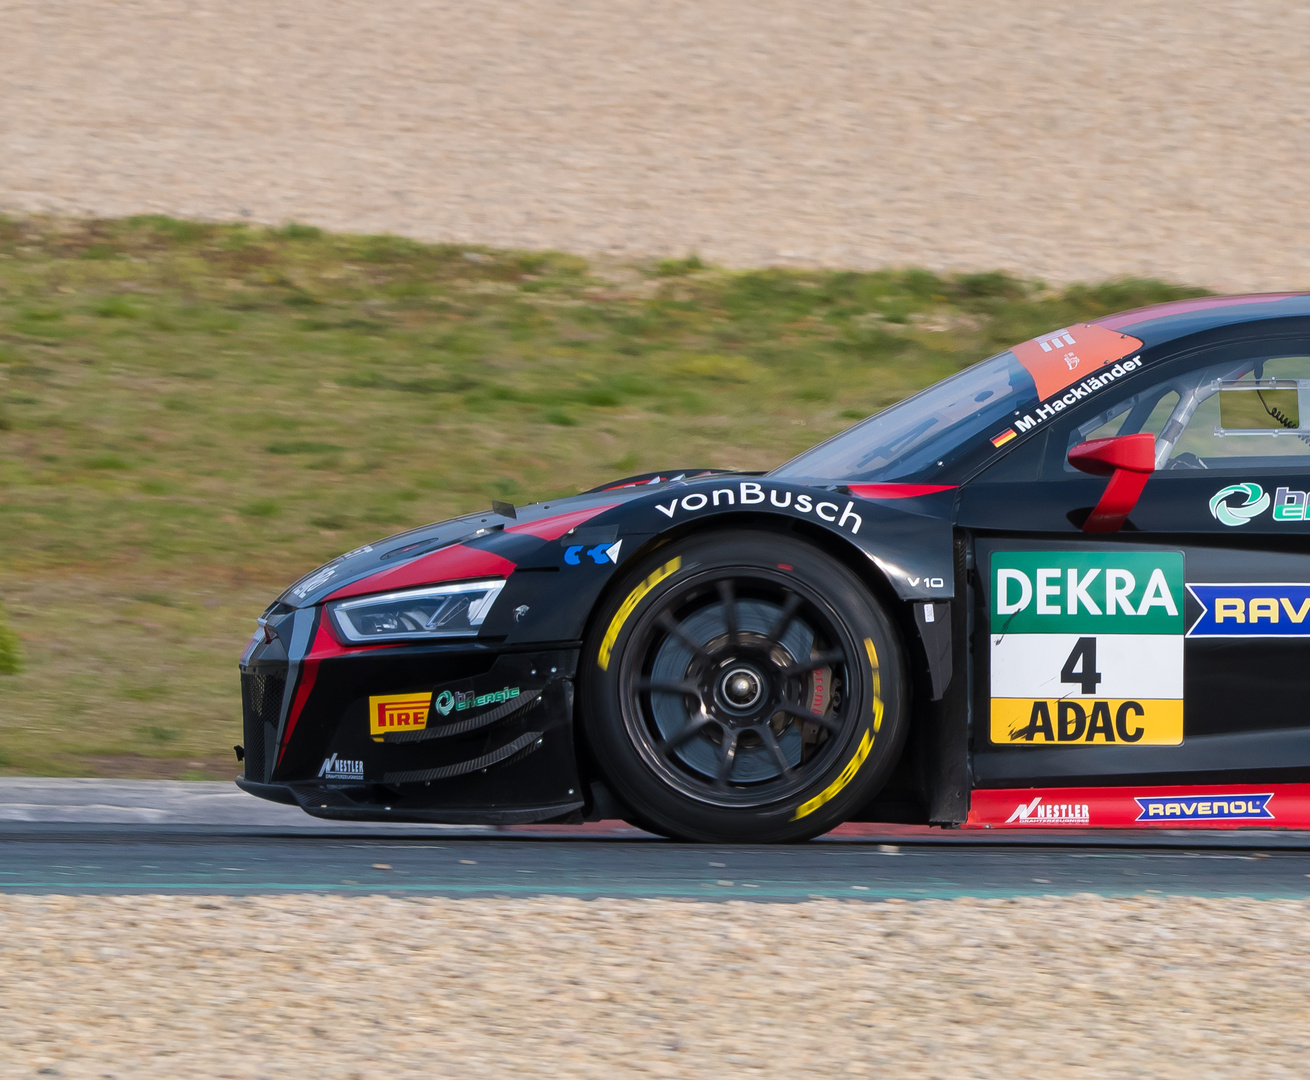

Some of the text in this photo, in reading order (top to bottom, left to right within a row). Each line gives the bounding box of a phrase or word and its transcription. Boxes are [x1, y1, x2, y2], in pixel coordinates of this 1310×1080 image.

[1014, 355, 1144, 433] M.Hackländer
[654, 482, 863, 535] vonBusch
[996, 568, 1179, 616] DEKRA
[1060, 637, 1101, 695] 4
[812, 668, 824, 715] brem
[1025, 701, 1145, 742] ADAC
[335, 760, 364, 773] NESTLER
[1037, 804, 1089, 818] NESTLER
[1148, 801, 1261, 816] RAVENOL
